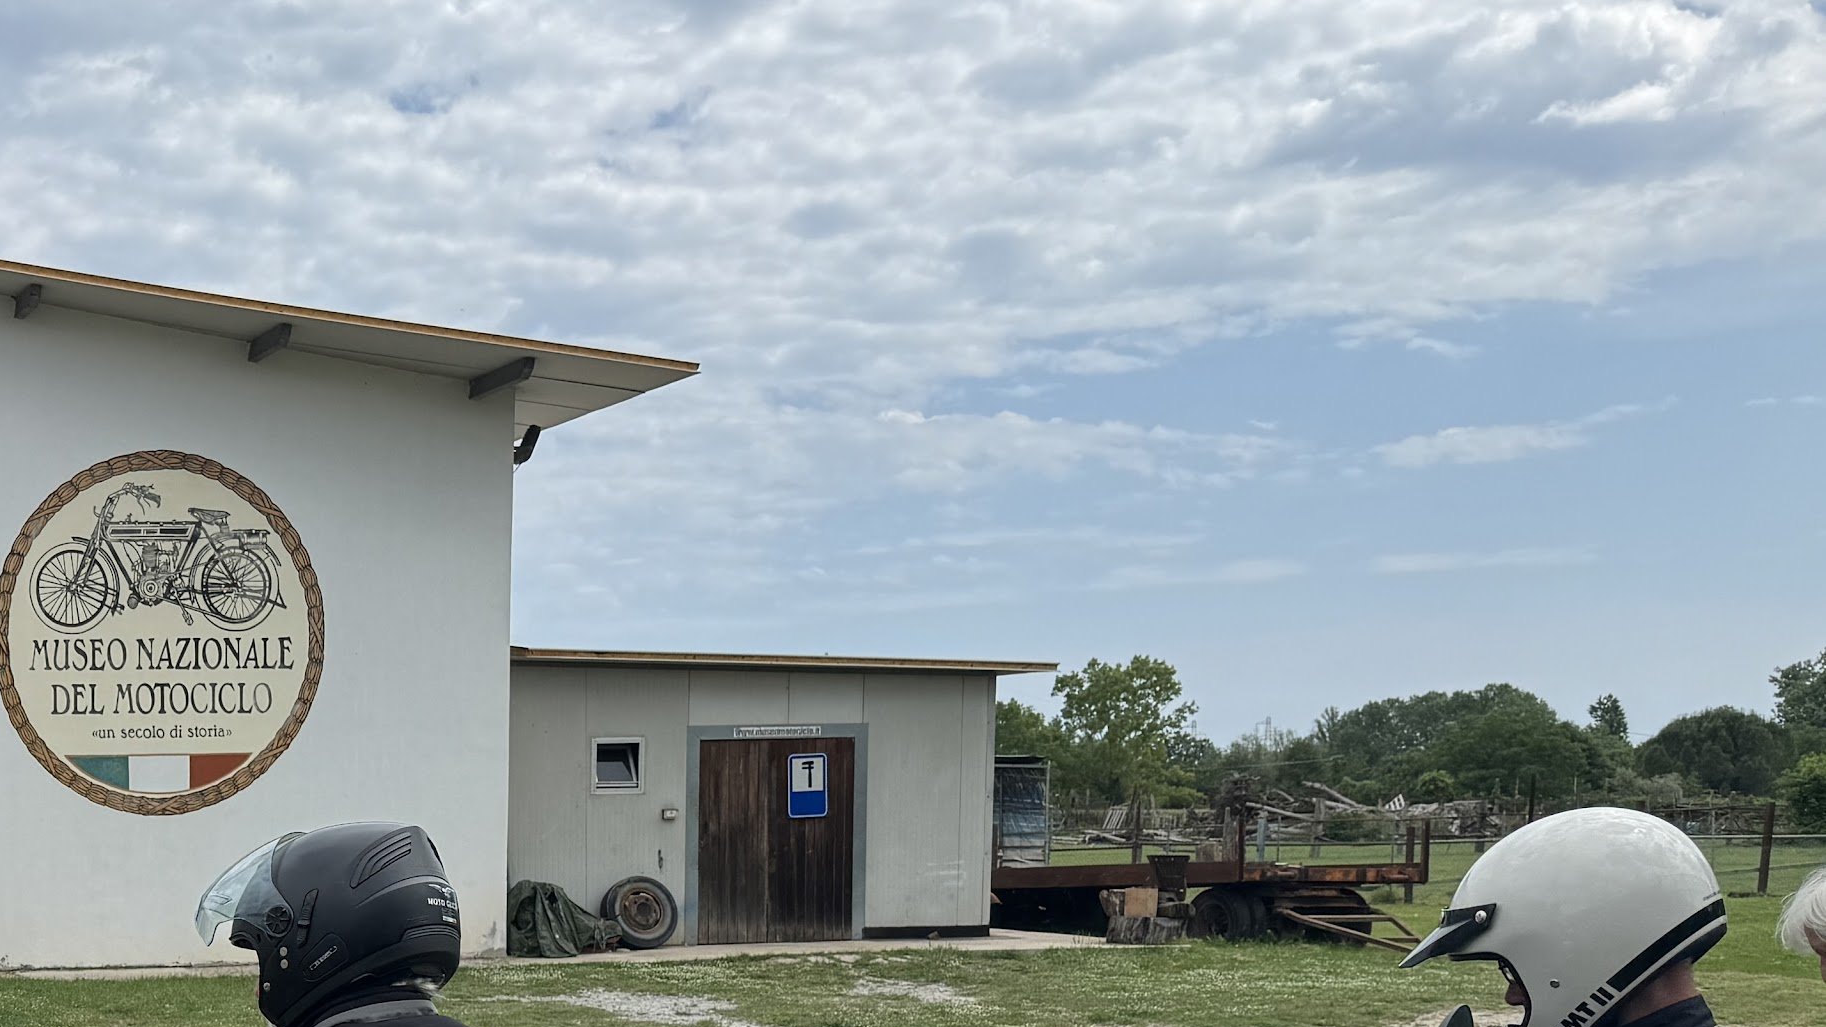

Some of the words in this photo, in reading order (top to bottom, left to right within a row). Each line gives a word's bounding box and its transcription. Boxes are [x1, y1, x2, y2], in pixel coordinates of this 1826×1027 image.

[29, 637, 127, 672] MUSEO
[135, 636, 295, 671] NAZIONALE
[50, 683, 105, 715] DEL
[112, 682, 273, 714] MOTOCICLO
[120, 726, 165, 739] secolo
[169, 725, 183, 739] di
